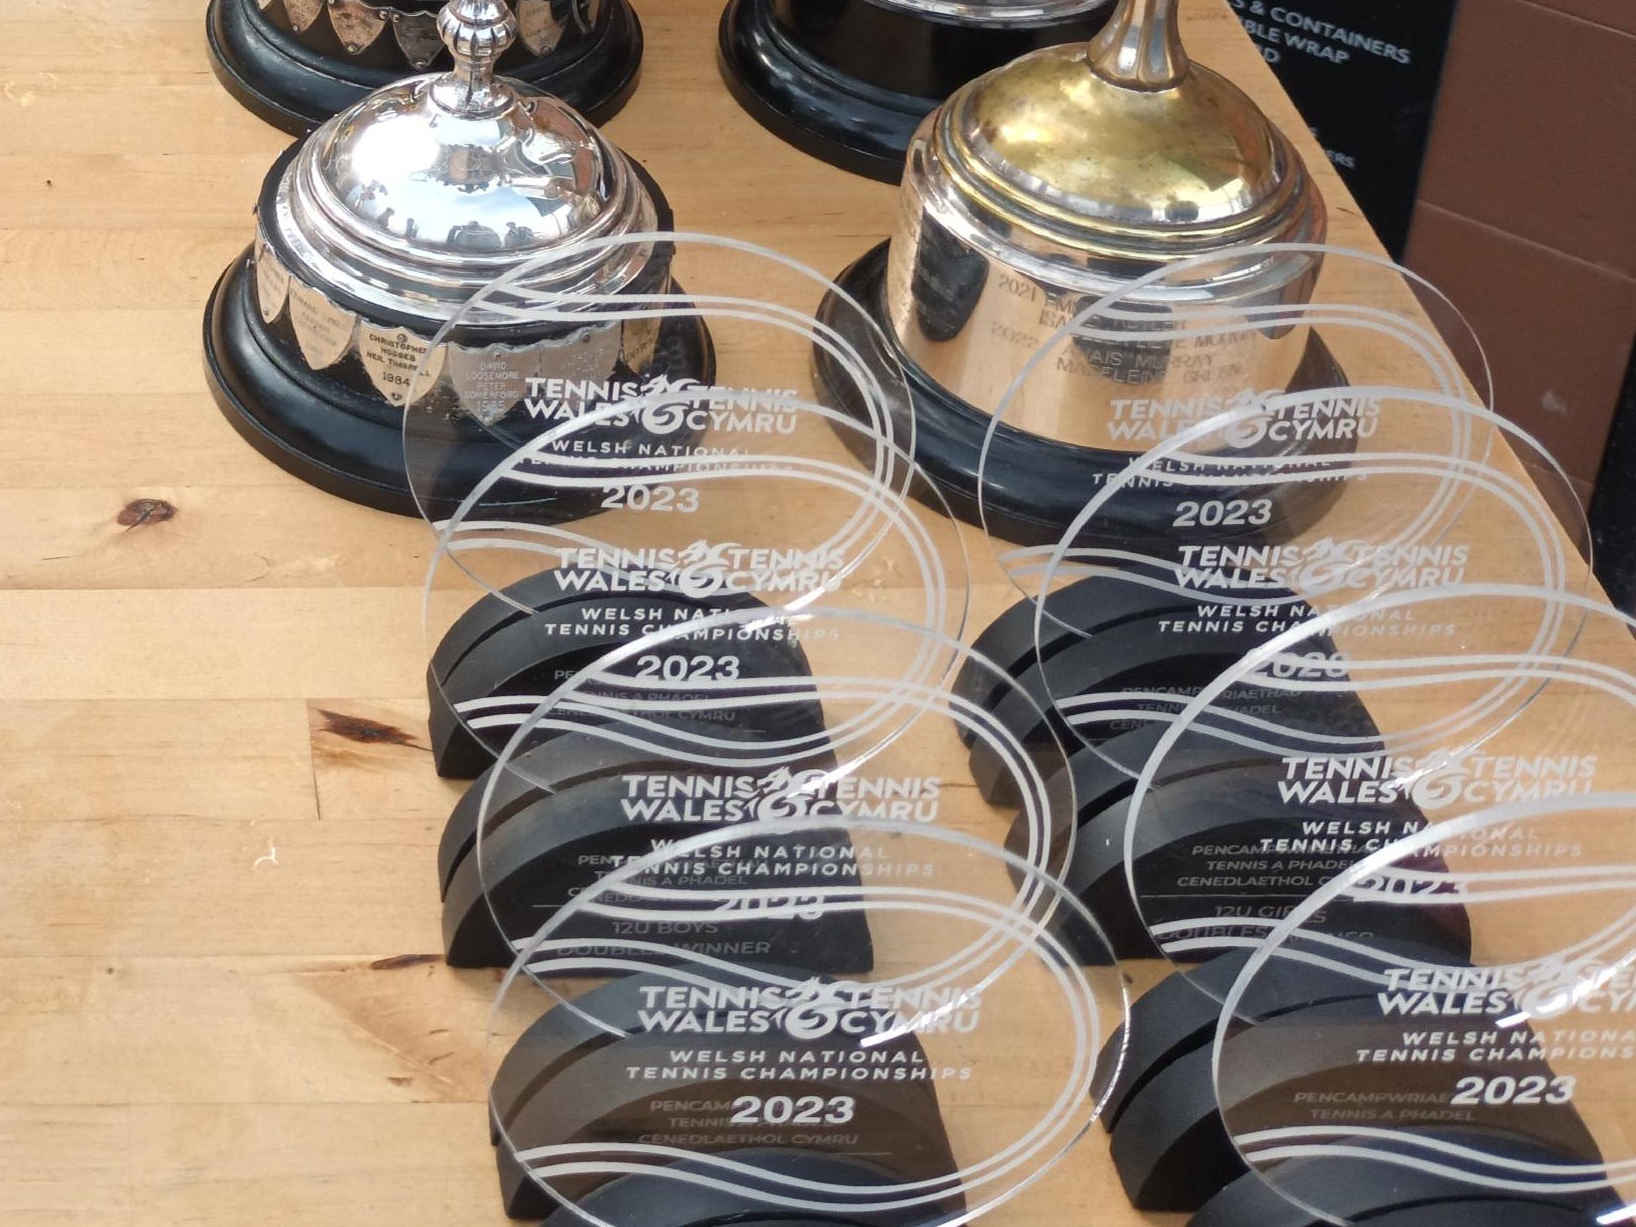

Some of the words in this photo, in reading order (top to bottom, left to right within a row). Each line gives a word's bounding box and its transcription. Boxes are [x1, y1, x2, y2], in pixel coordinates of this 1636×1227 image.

[1270, 6, 1411, 65] CONTAINERS
[1285, 30, 1351, 65] WRAP
[380, 346, 416, 363] HODGES
[1135, 349, 1213, 370] MURRAY
[382, 371, 412, 388] 1984
[466, 371, 519, 381] LOOSEMORE
[524, 377, 642, 402] TENNIS
[686, 410, 798, 434] CYMRU
[1268, 418, 1379, 441] CYMRU
[552, 439, 628, 455] WELSH
[601, 484, 701, 513] 2023
[1172, 499, 1273, 528] 2023
[554, 547, 680, 570] TENNIS
[728, 548, 846, 570] TENNIS
[1177, 544, 1301, 569] TENNIS
[553, 569, 665, 592] WALES
[722, 570, 844, 593] CYMRU
[1174, 567, 1293, 590] WALES
[1345, 566, 1465, 589] CYMRU
[581, 607, 663, 621] WELSH
[1196, 604, 1278, 618] WELSH
[545, 623, 631, 636] TENNIS
[1158, 619, 1245, 633] TENNIS
[636, 654, 740, 682] 2023
[1281, 755, 1414, 781] TENNIS
[1470, 755, 1598, 775] TENNIS
[622, 774, 756, 800] TENNIS
[814, 775, 941, 800] TENNIS
[1276, 779, 1400, 805] WALES
[620, 798, 745, 823] WALES
[810, 799, 939, 823] CYMRU
[1301, 820, 1392, 835] WELSH
[754, 844, 889, 860] NATIONAL
[1260, 838, 1359, 852] TENNIS
[718, 862, 936, 878] CHAMPIONSHIPS
[1176, 876, 1314, 889] CENEDLAETHOL
[1213, 905, 1253, 919] 12U
[612, 921, 650, 935] 12U
[656, 920, 719, 935] BOYS
[640, 984, 785, 1010] TENNIS
[845, 985, 983, 1009] TENNIS
[1377, 991, 1510, 1015] WALES
[637, 1009, 771, 1034] WALES
[840, 1010, 980, 1034] CYMRU
[1402, 1030, 1499, 1046] WELSH
[669, 1049, 766, 1064] WELSH
[779, 1049, 924, 1064] NATIONAL
[1357, 1048, 1456, 1063] TENNIS
[626, 1066, 727, 1080] TENNIS
[740, 1066, 973, 1081] CHAMPIONSHIPS
[1450, 1076, 1576, 1106] 2023
[730, 1095, 856, 1125] 2023
